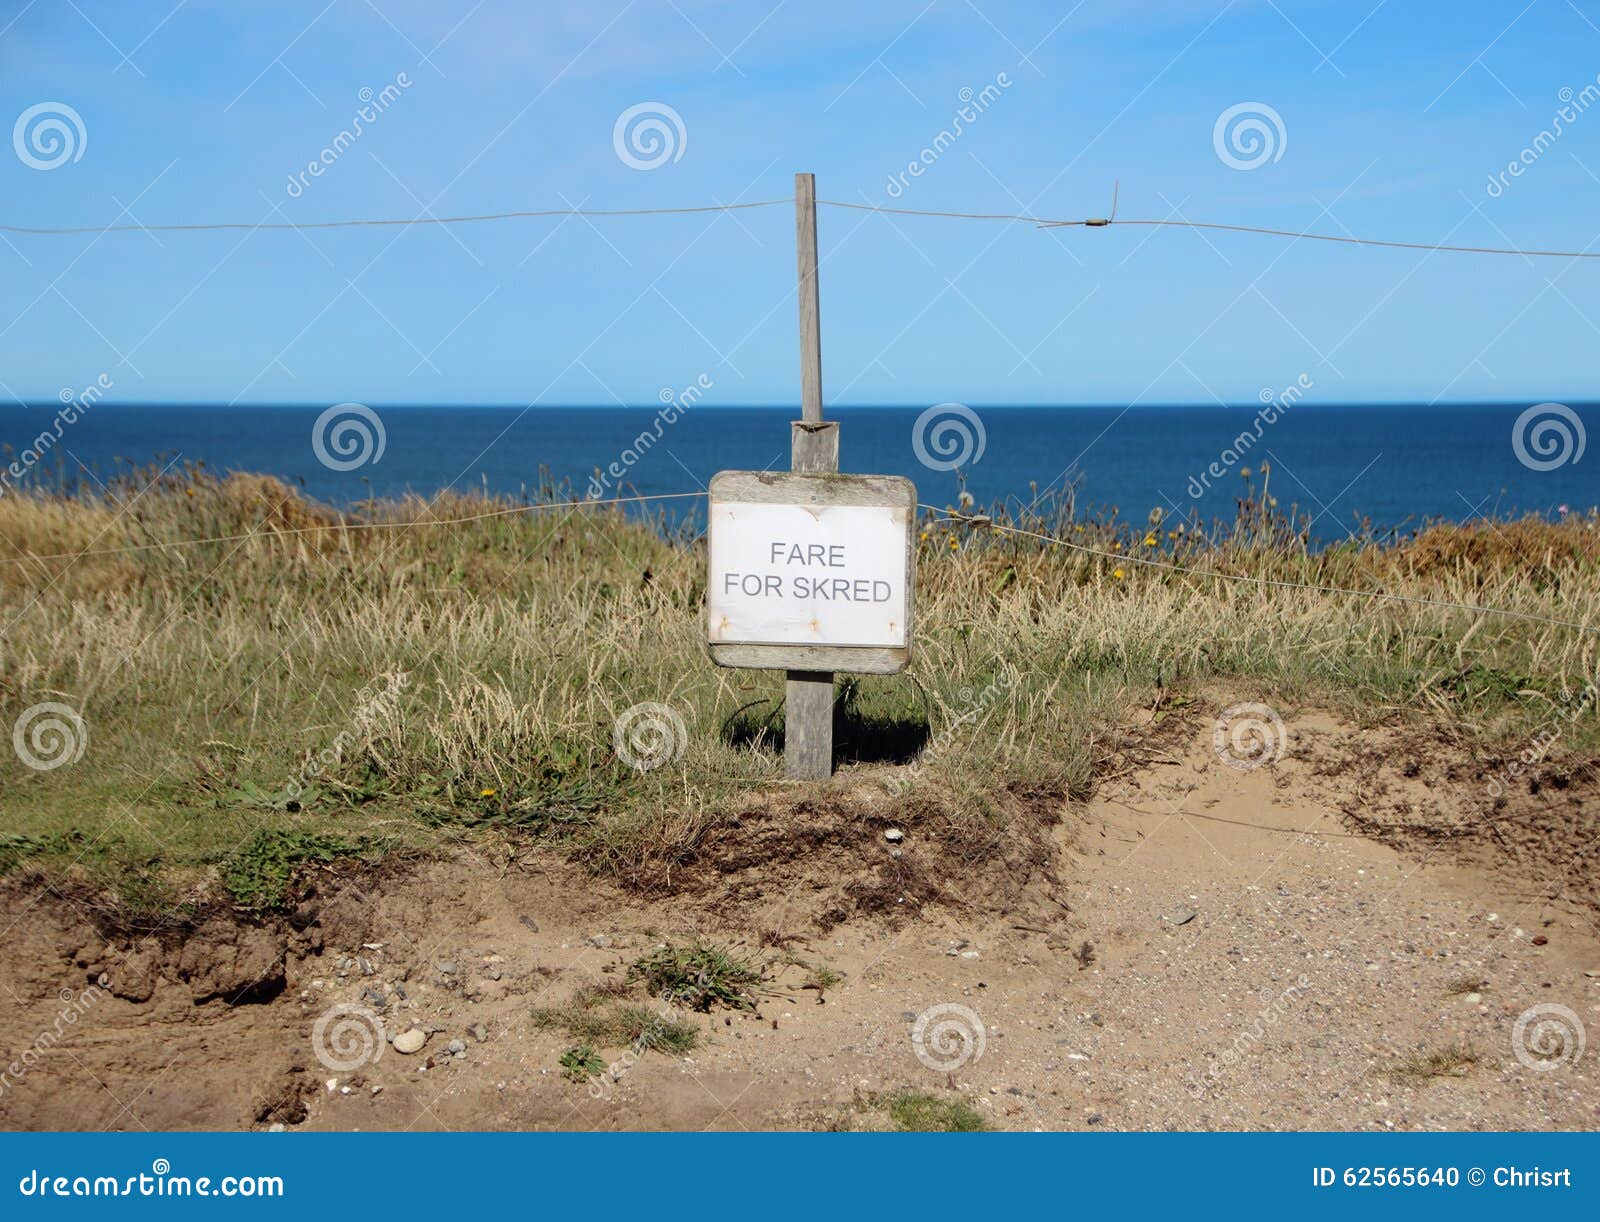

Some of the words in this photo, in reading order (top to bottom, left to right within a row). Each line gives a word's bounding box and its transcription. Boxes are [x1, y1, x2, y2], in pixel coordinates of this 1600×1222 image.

[770, 542, 846, 567] FARE
[724, 573, 784, 597] FOR
[792, 577, 892, 603] SKRED
